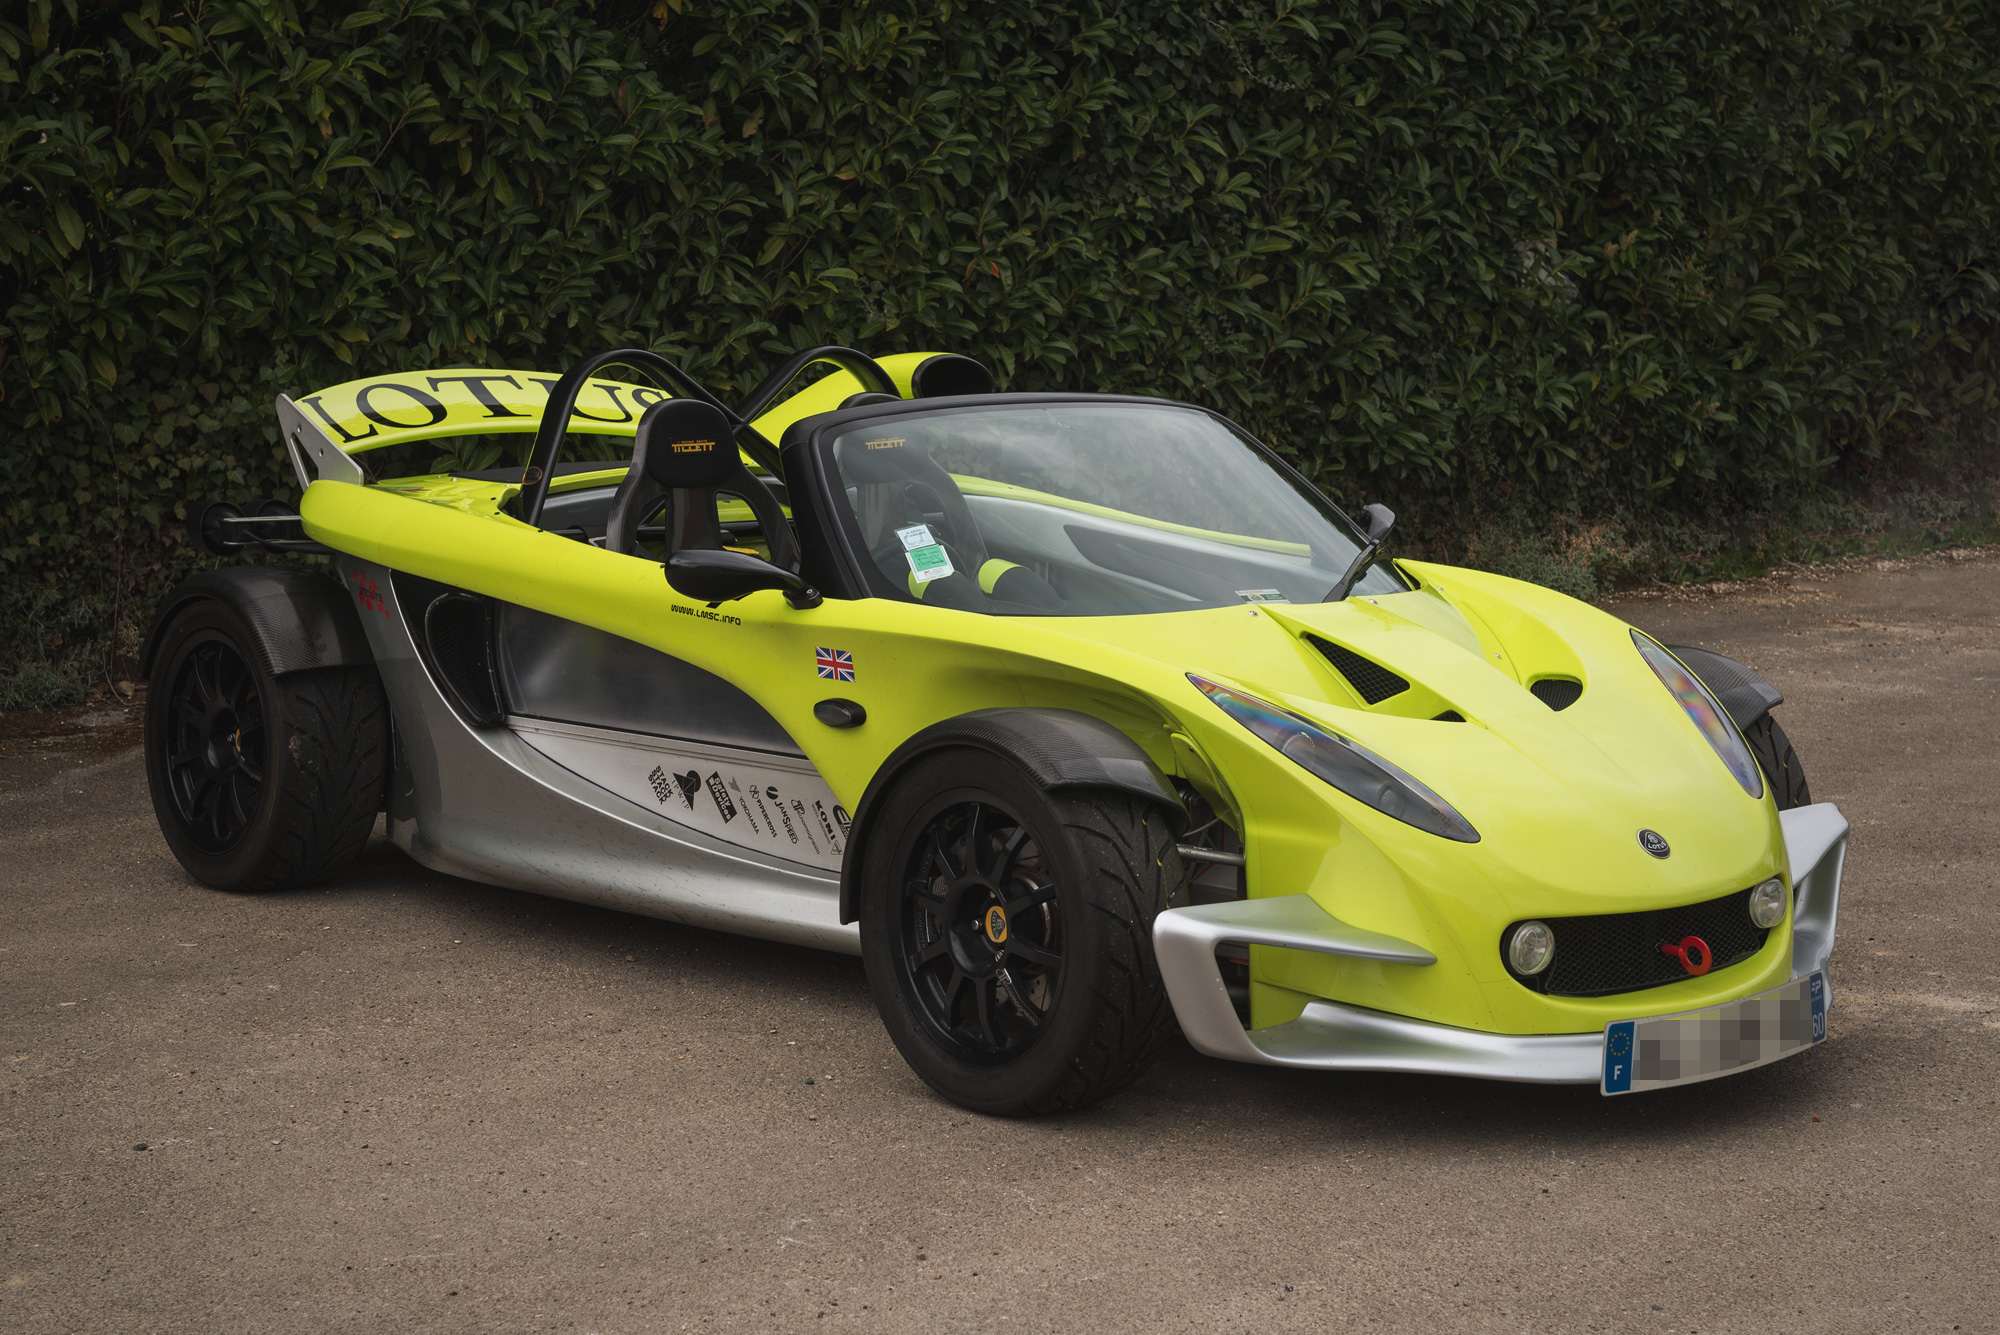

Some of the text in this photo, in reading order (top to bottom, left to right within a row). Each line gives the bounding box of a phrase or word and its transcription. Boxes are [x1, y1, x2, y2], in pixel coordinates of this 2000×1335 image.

[648, 774, 665, 806] STACK
[652, 769, 669, 802] STACK
[656, 766, 674, 798] STACK
[713, 776, 731, 806] Safety
[711, 785, 732, 820] Devices
[739, 796, 760, 835] YOKOHAMA
[757, 798, 778, 838] PIPERCROSS
[815, 799, 836, 840] KONI
[1812, 1011, 1824, 1037] 60
[1613, 1064, 1623, 1081] F
